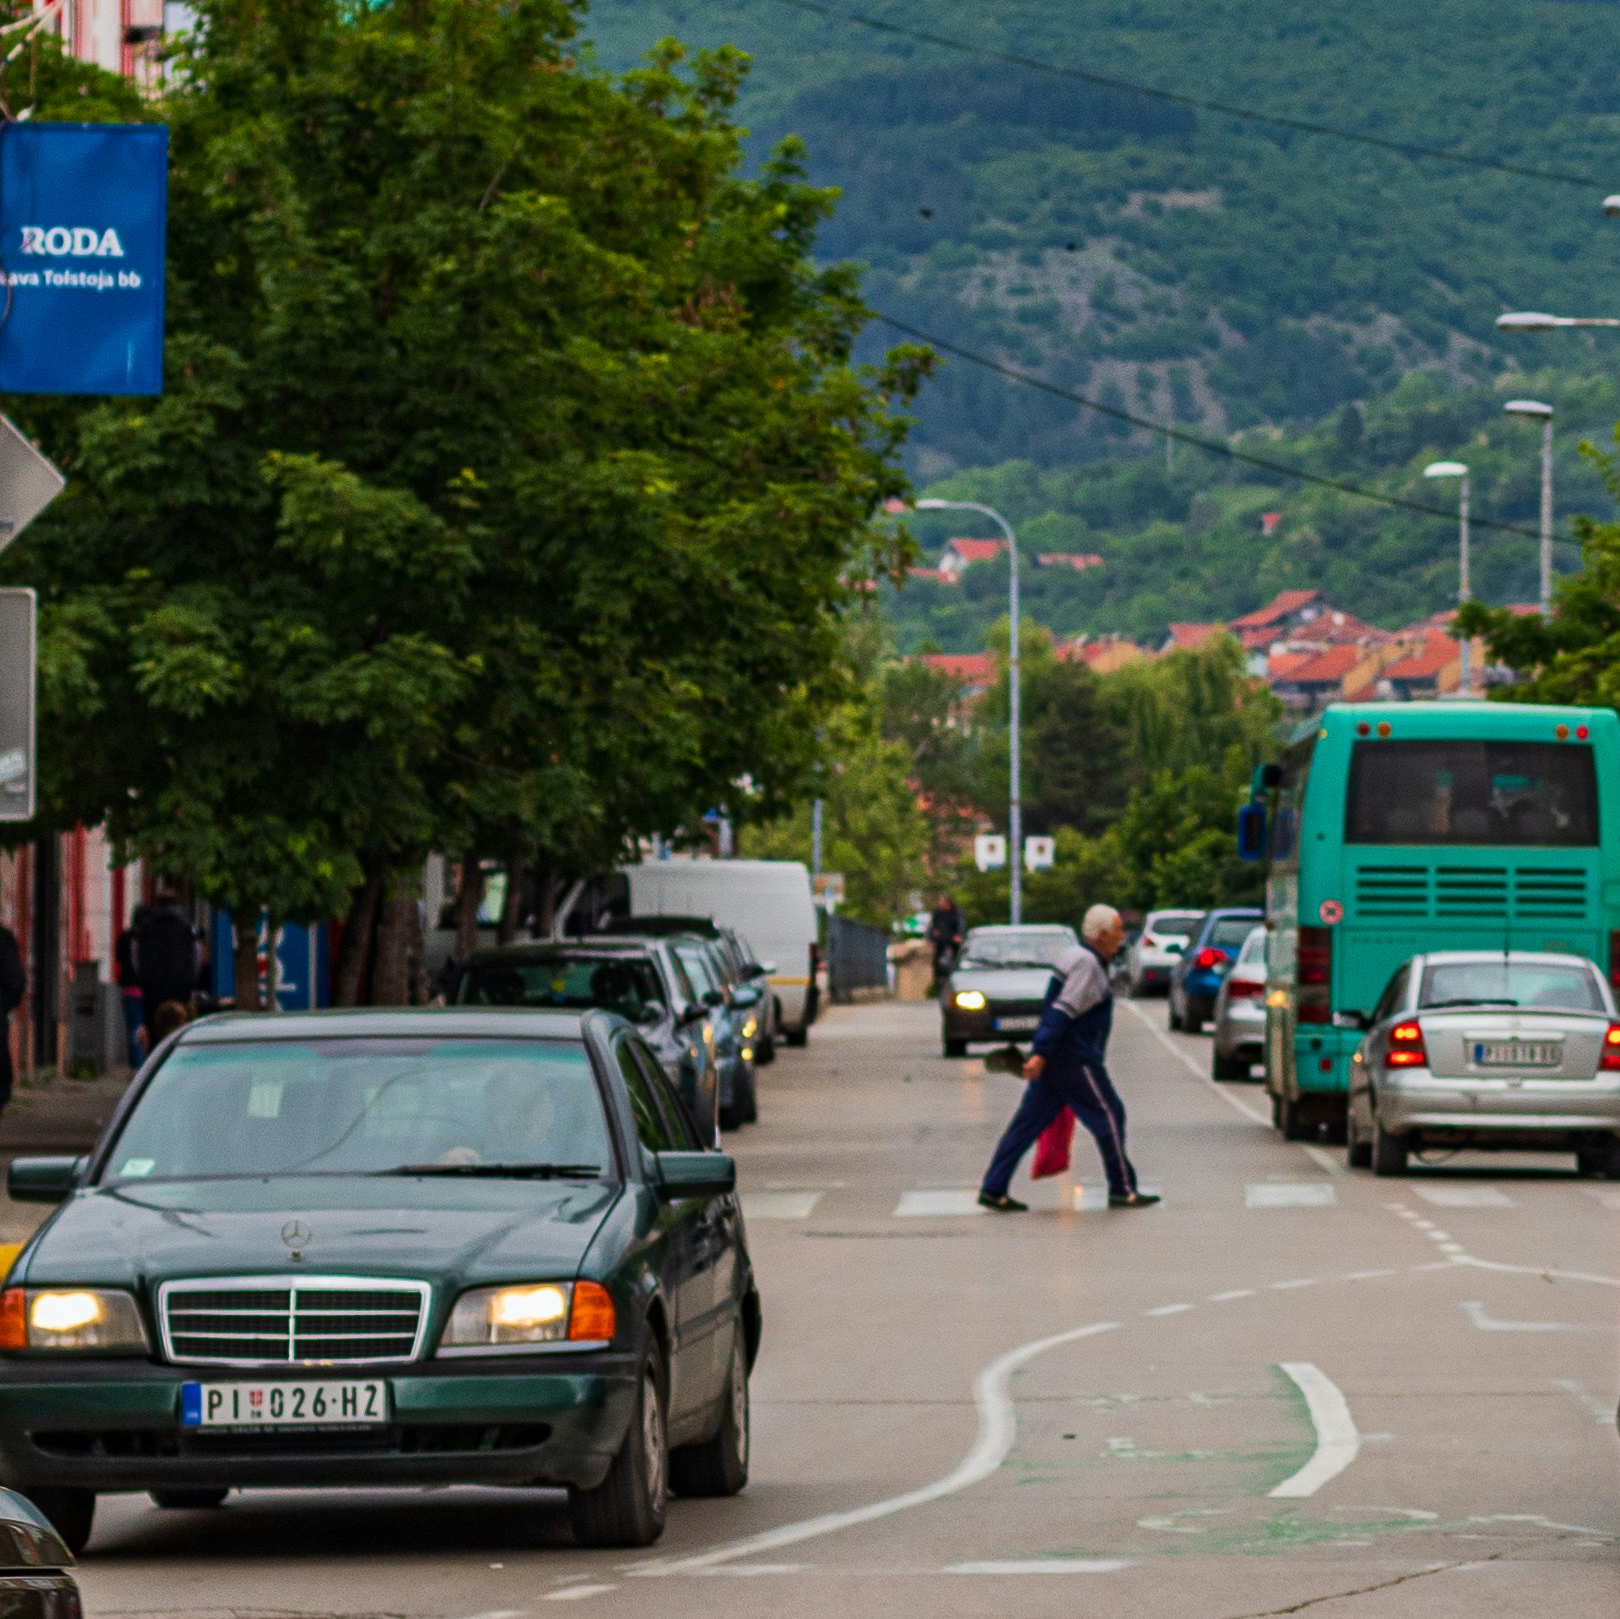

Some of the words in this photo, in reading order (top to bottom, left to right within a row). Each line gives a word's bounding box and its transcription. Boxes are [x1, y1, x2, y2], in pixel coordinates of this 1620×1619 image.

[20, 226, 124, 257] RODA
[43, 269, 114, 291] Tolstoja
[118, 271, 142, 288] bb
[207, 1389, 239, 1420] PI
